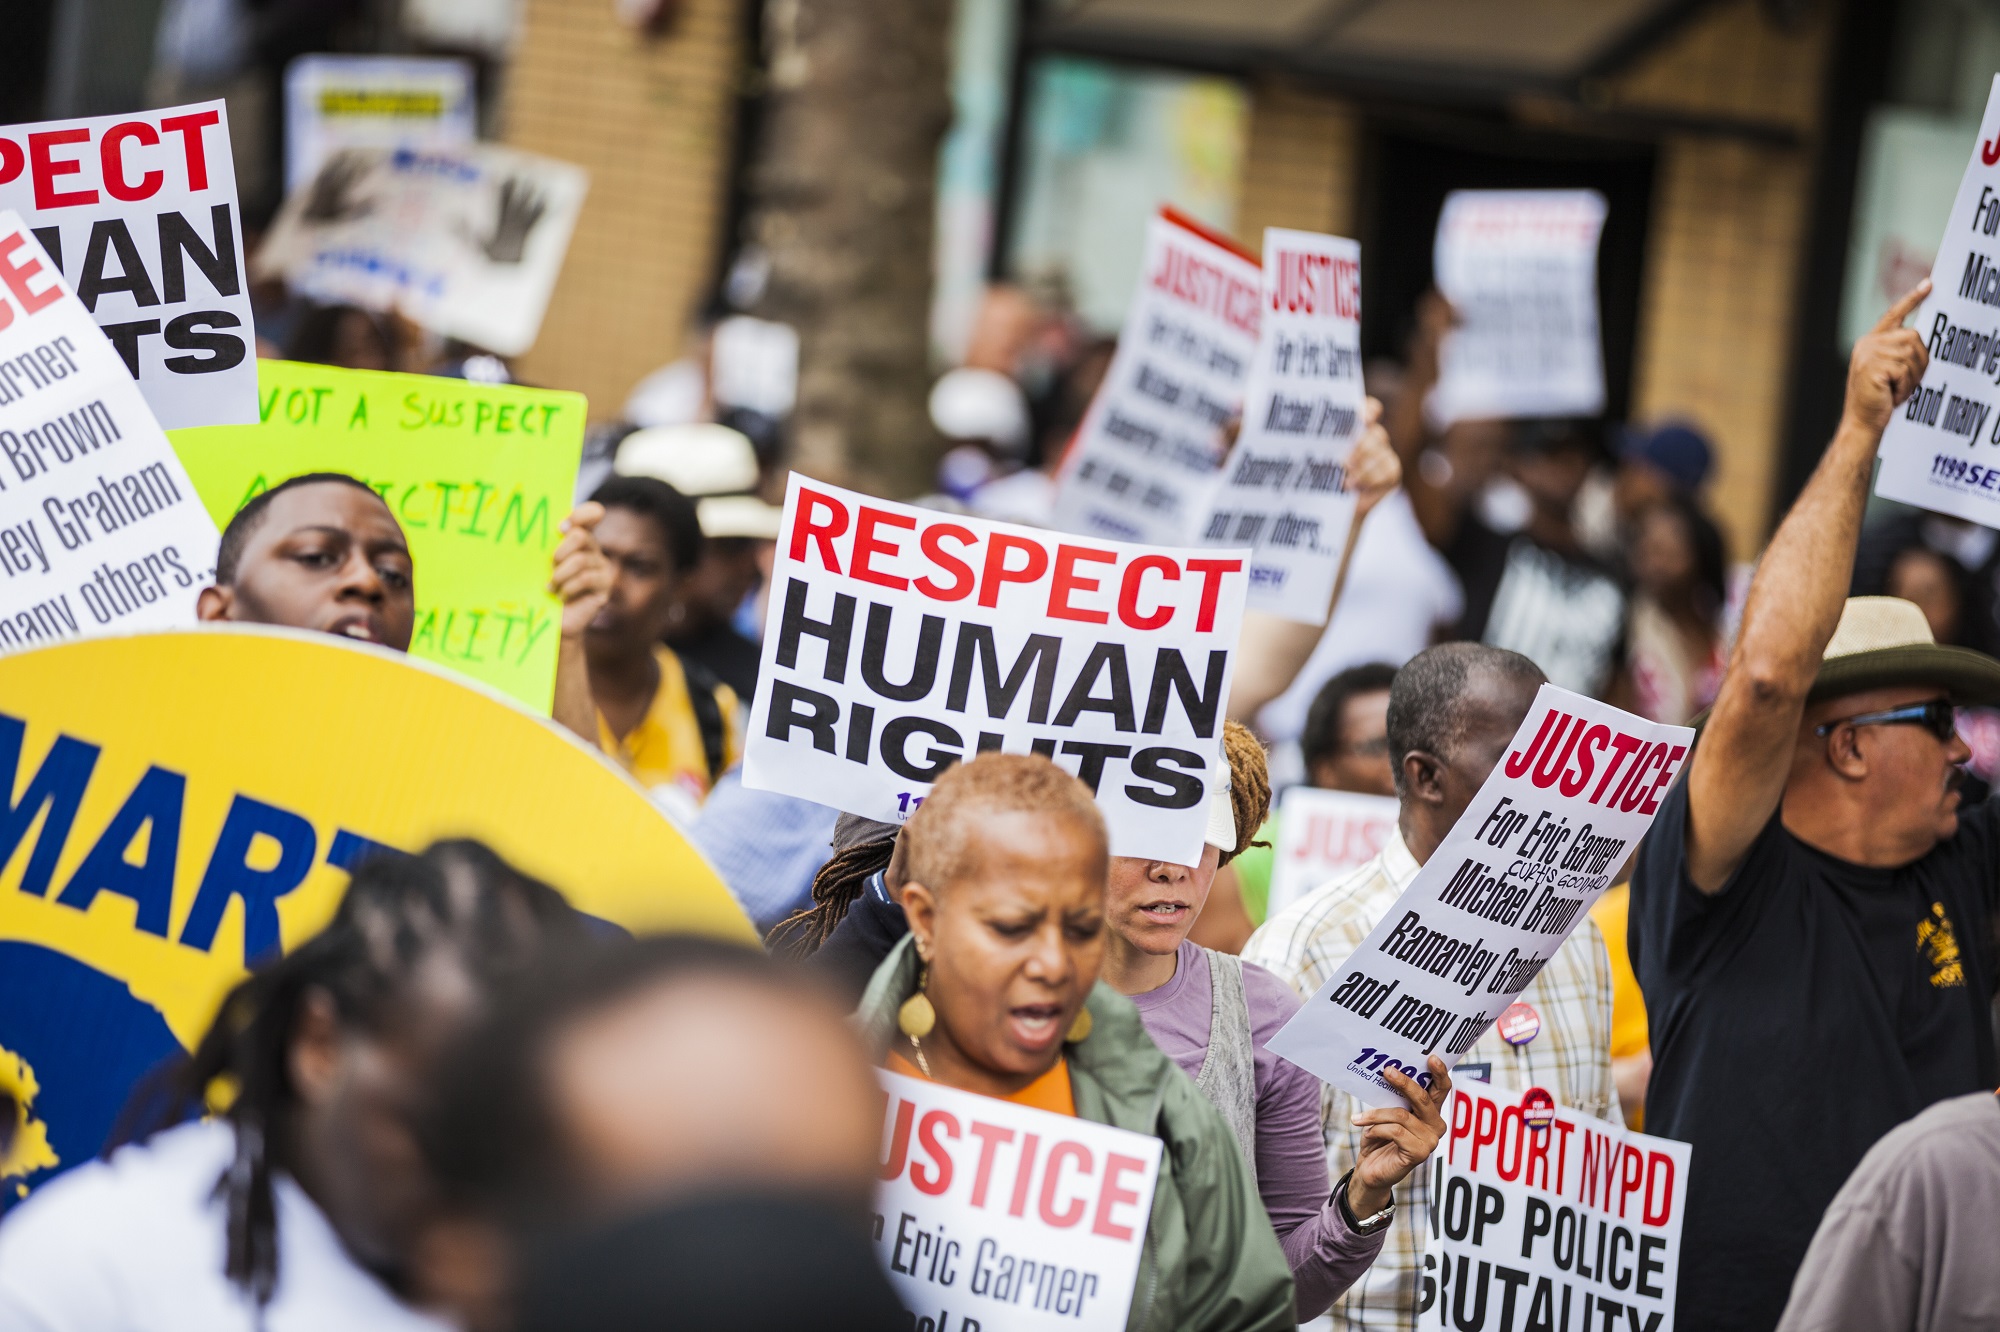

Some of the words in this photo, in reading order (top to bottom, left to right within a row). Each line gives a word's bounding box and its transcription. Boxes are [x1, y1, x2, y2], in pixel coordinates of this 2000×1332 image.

[0, 399, 121, 482] Brown
[349, 393, 368, 430] A
[1942, 394, 1991, 447] many
[42, 460, 182, 551] Graham
[789, 486, 1243, 633] RESPECT
[413, 604, 552, 666] ALITY
[775, 577, 1228, 738] HUMAN
[766, 678, 1206, 810] RIGTS
[1504, 709, 1687, 816] JUSTICE
[1474, 796, 1529, 849] For
[1516, 810, 1571, 865] Eric
[1560, 823, 1626, 875] Garner
[1438, 858, 1540, 928] Michael
[1521, 885, 1584, 935] Brown
[1378, 910, 1501, 997] Ramarley
[1330, 971, 1401, 1020] and
[1379, 993, 1459, 1056] many
[1346, 1062, 1375, 1081] United
[1579, 1127, 1675, 1228] NYPD
[891, 1211, 960, 1287] Eric
[970, 1237, 1098, 1319] Garner
[1521, 1196, 1667, 1300] POLICE
